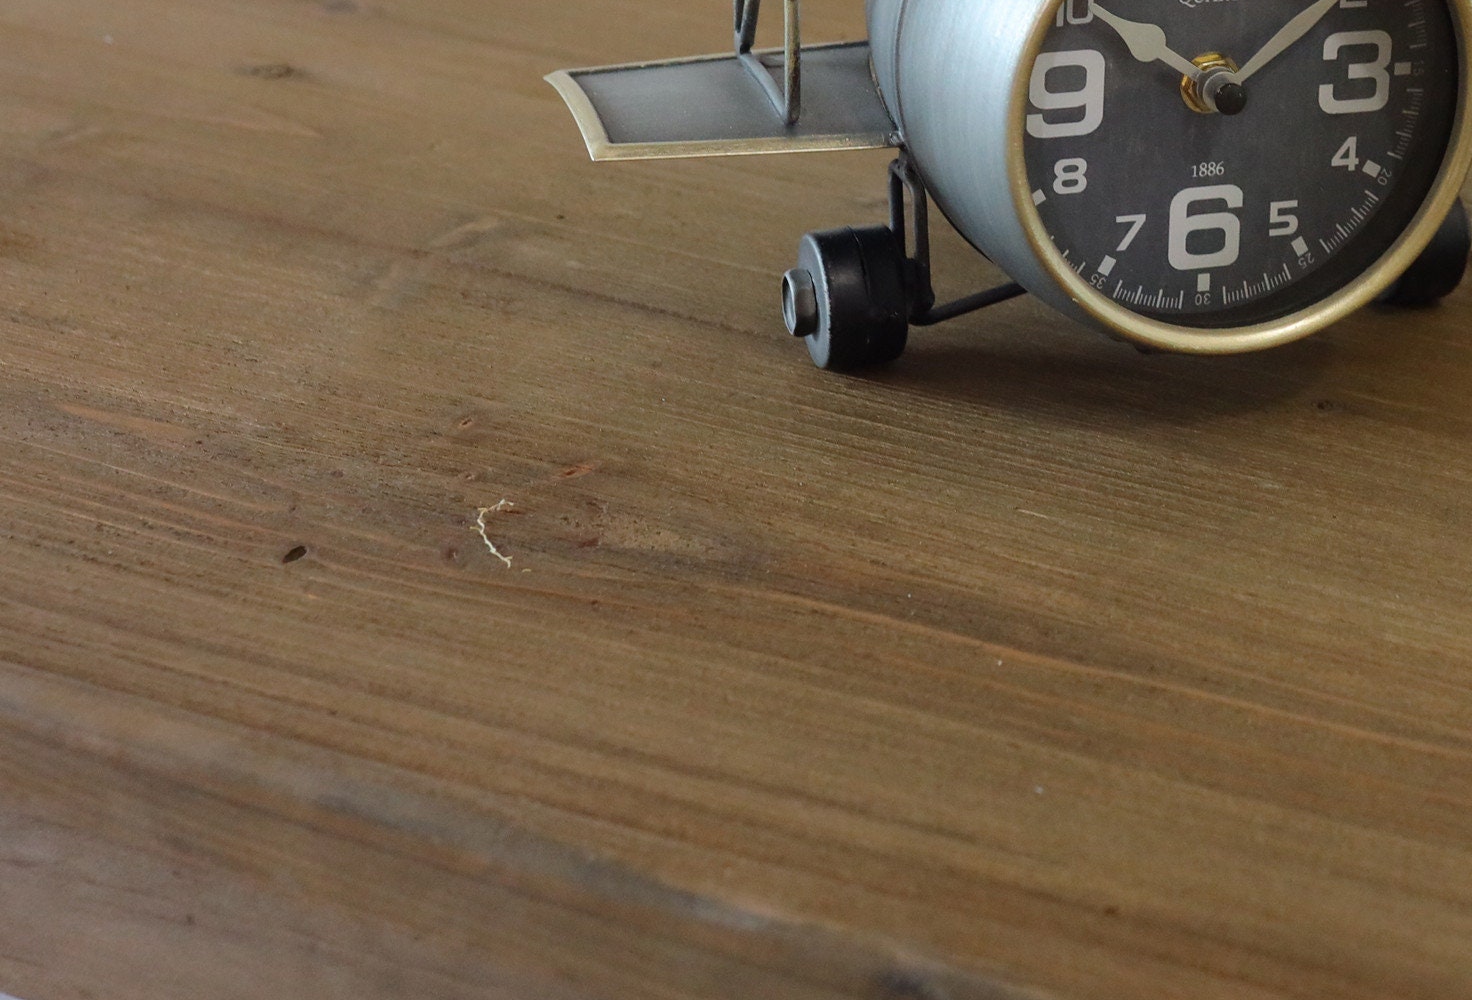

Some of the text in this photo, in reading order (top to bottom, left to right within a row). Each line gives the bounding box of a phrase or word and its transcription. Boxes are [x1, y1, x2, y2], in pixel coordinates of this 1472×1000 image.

[1318, 29, 1393, 114] 3
[1026, 49, 1105, 139] 9
[1191, 161, 1225, 178] 1886
[1331, 136, 1360, 171] 4
[1052, 157, 1088, 195] 8
[1377, 167, 1393, 186] 20
[1115, 213, 1147, 251] 7
[1168, 184, 1244, 271] 6
[1268, 199, 1299, 237] 5
[1297, 251, 1315, 269] 25
[1089, 273, 1107, 290] 35
[1194, 292, 1212, 306] 30
